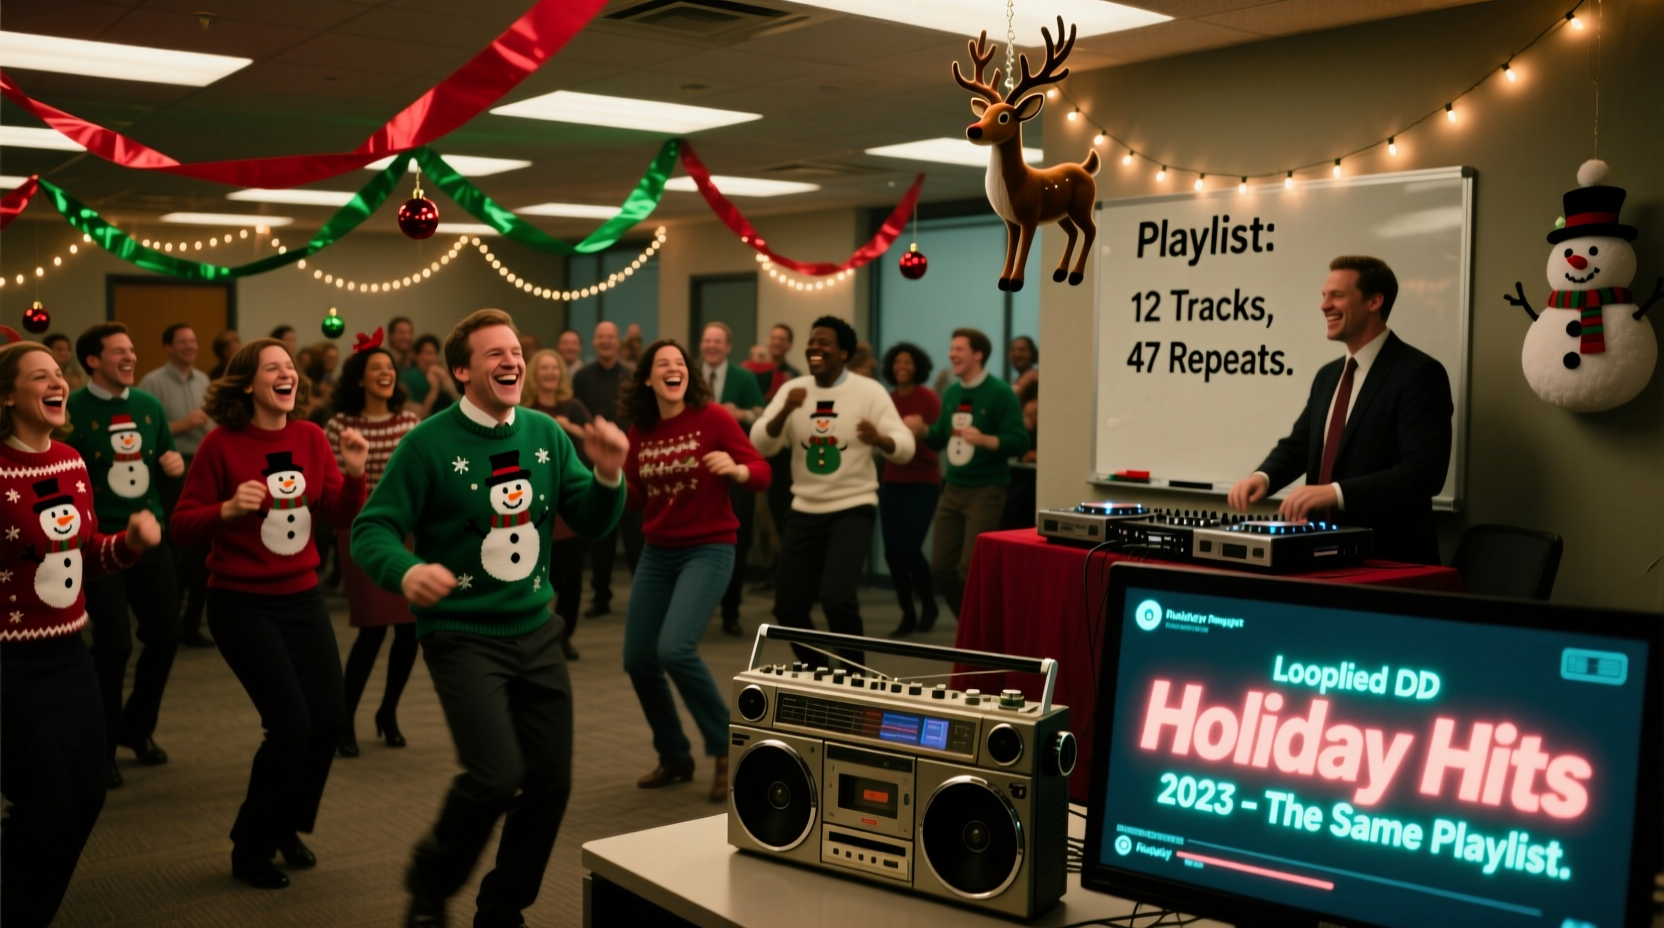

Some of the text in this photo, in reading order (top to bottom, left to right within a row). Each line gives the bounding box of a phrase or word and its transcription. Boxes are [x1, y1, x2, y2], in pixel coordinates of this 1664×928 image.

[1137, 214, 1275, 267] Playlist:
[1131, 288, 1274, 329] 12 Tracks,
[1126, 341, 1294, 383] 47 Repeats.
[1273, 655, 1441, 700] Looplied DD
[1139, 680, 1594, 820] Holiday Hits
[1157, 773, 1237, 816] 2023
[1264, 790, 1324, 833] The
[1329, 802, 1424, 851] Same
[1430, 819, 1572, 880] Playlist.
